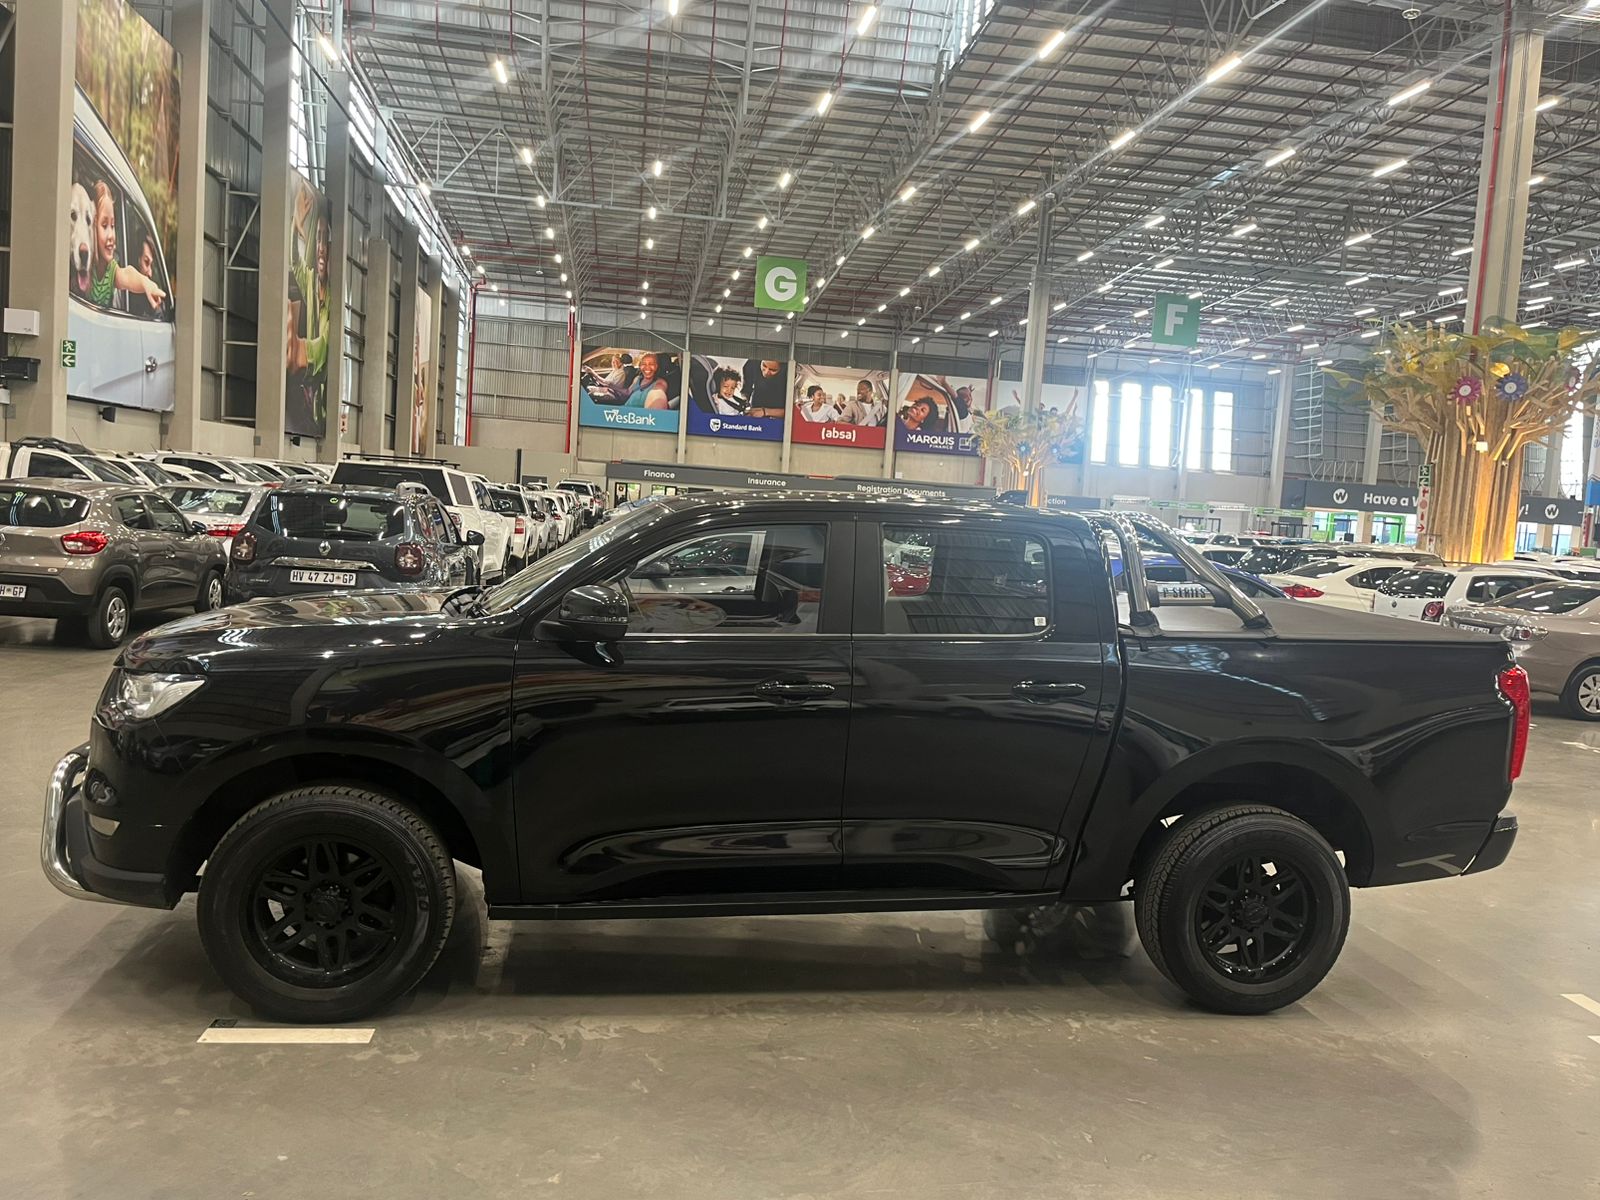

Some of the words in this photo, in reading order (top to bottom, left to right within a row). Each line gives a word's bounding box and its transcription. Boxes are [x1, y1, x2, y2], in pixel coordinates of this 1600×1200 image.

[764, 266, 797, 302] G
[1164, 303, 1188, 336] F
[603, 409, 656, 426] WesBank
[722, 422, 747, 431] Standard
[748, 424, 762, 432] Bank
[821, 427, 857, 442] (absa)
[907, 433, 955, 446] MARQUIS
[643, 469, 676, 479] Finance
[747, 477, 787, 487] Insurance
[857, 484, 902, 494] Registration
[903, 487, 946, 497] Documents
[1047, 497, 1066, 505] ction
[1363, 492, 1398, 506] Have
[1400, 497, 1409, 506] a
[292, 571, 304, 581] HV
[308, 573, 319, 582] 47
[323, 573, 335, 583] ZJ
[342, 574, 354, 584] GP
[12, 587, 24, 596] GP
